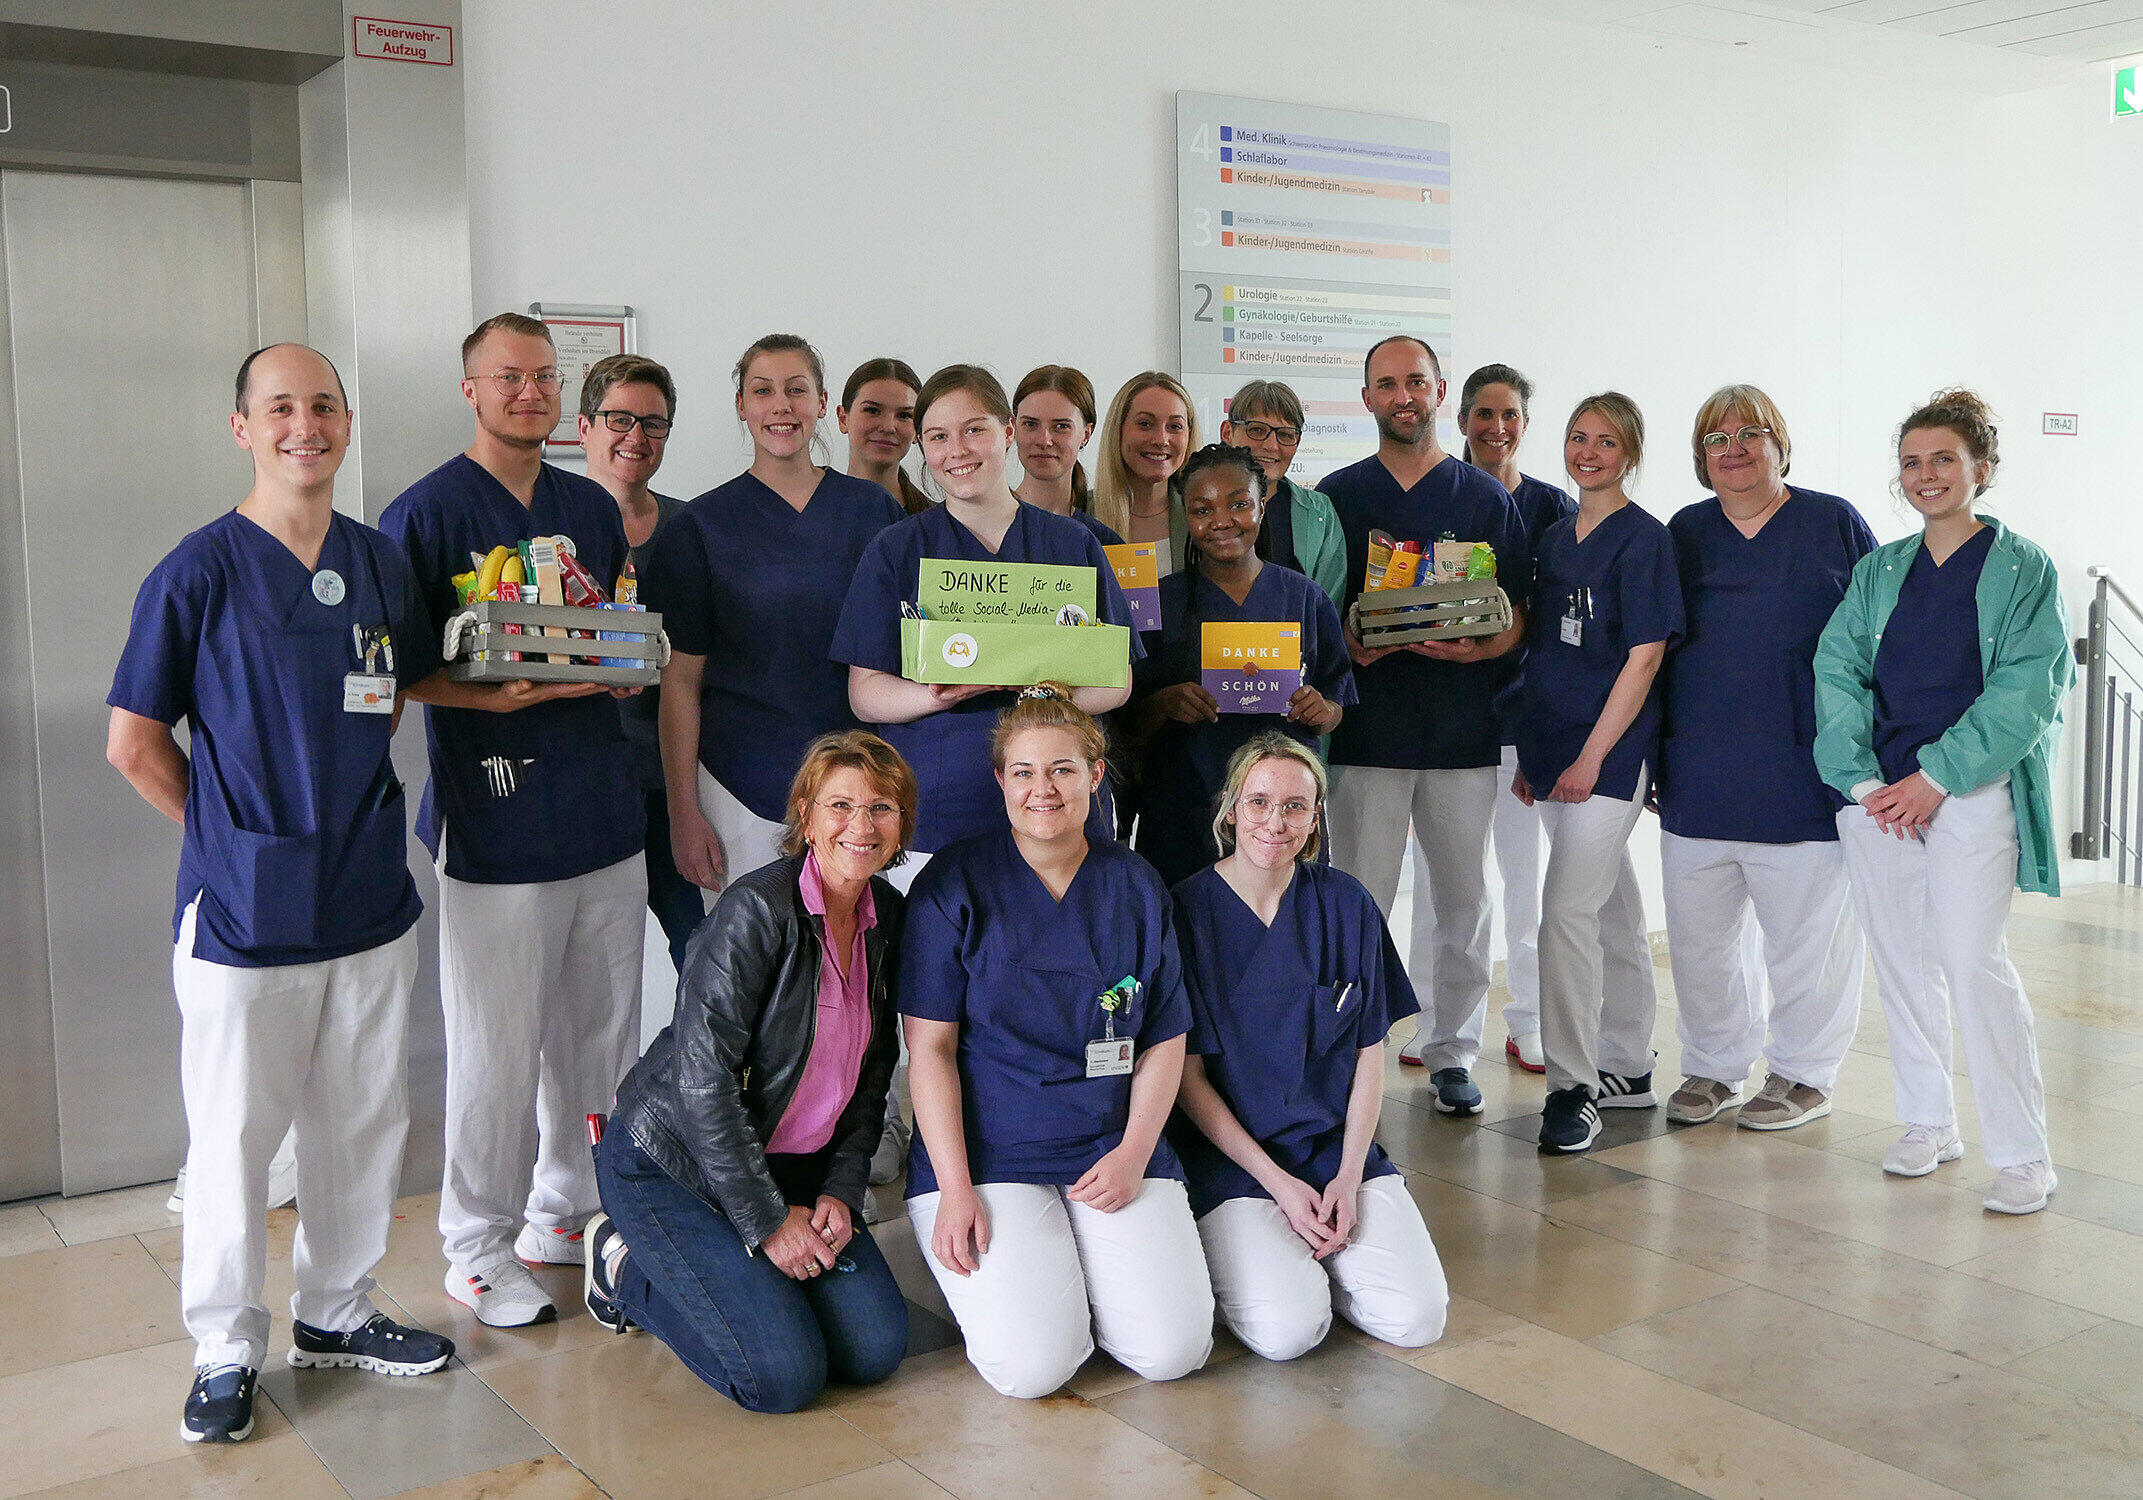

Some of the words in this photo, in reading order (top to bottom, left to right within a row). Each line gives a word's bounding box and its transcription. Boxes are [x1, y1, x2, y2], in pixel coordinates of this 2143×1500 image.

[367, 23, 441, 42] Feuerwehr-
[382, 42, 427, 59] Aufzug
[1190, 123, 1213, 162] 4
[1236, 130, 1260, 143] Med.
[1262, 133, 1287, 146] Klinik
[1236, 150, 1288, 166] Schlaflabor
[1237, 172, 1340, 192] Kinder-/Jugendmedizin
[1192, 208, 1212, 247] 3
[1237, 216, 1254, 224] Station
[1264, 218, 1281, 226] Station
[1290, 220, 1306, 228] Station
[1238, 235, 1341, 252] Kinder-/Jugendmedizin
[1193, 283, 1214, 323] 2
[1239, 288, 1278, 302] Urologie
[1279, 294, 1296, 302] Station
[1239, 308, 1353, 325] Gynäkologie/Geburtshilfe
[1379, 320, 1395, 328] Station
[1239, 330, 1273, 343] Kapelle
[1280, 332, 1323, 345] Seelsorge
[1239, 350, 1342, 365] Kinder-/Jugendmedizin
[2049, 418, 2073, 430] TR-A2
[939, 570, 1009, 593] DANKE
[1030, 576, 1047, 595] für
[1055, 578, 1073, 592] die
[938, 602, 965, 615] tolle
[1222, 647, 1280, 658] DANKE
[1221, 680, 1279, 691] SCHÖN
